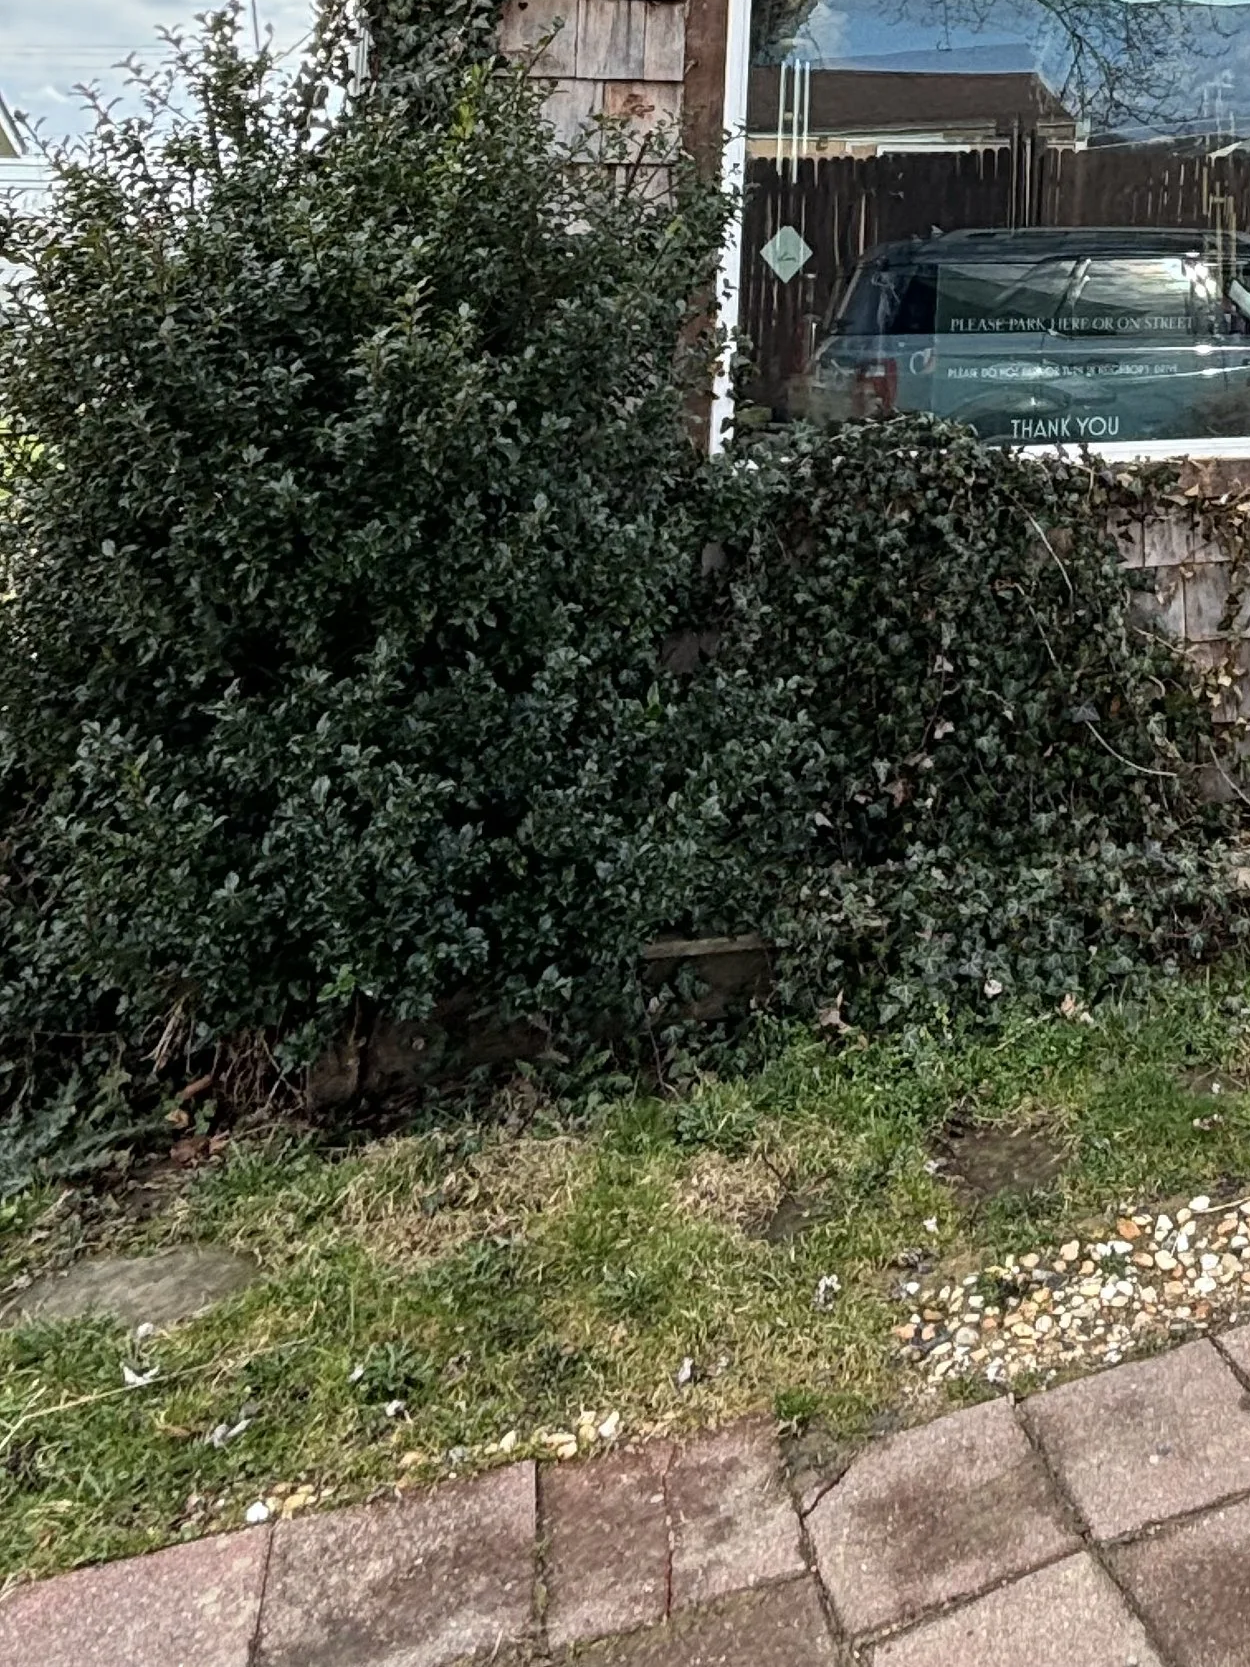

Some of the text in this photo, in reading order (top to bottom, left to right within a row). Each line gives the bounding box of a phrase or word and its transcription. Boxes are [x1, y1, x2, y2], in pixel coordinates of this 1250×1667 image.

[950, 316, 1193, 331] PLEASE PARK HERE OR ON STREET
[1010, 415, 1120, 439] THANK YOU
